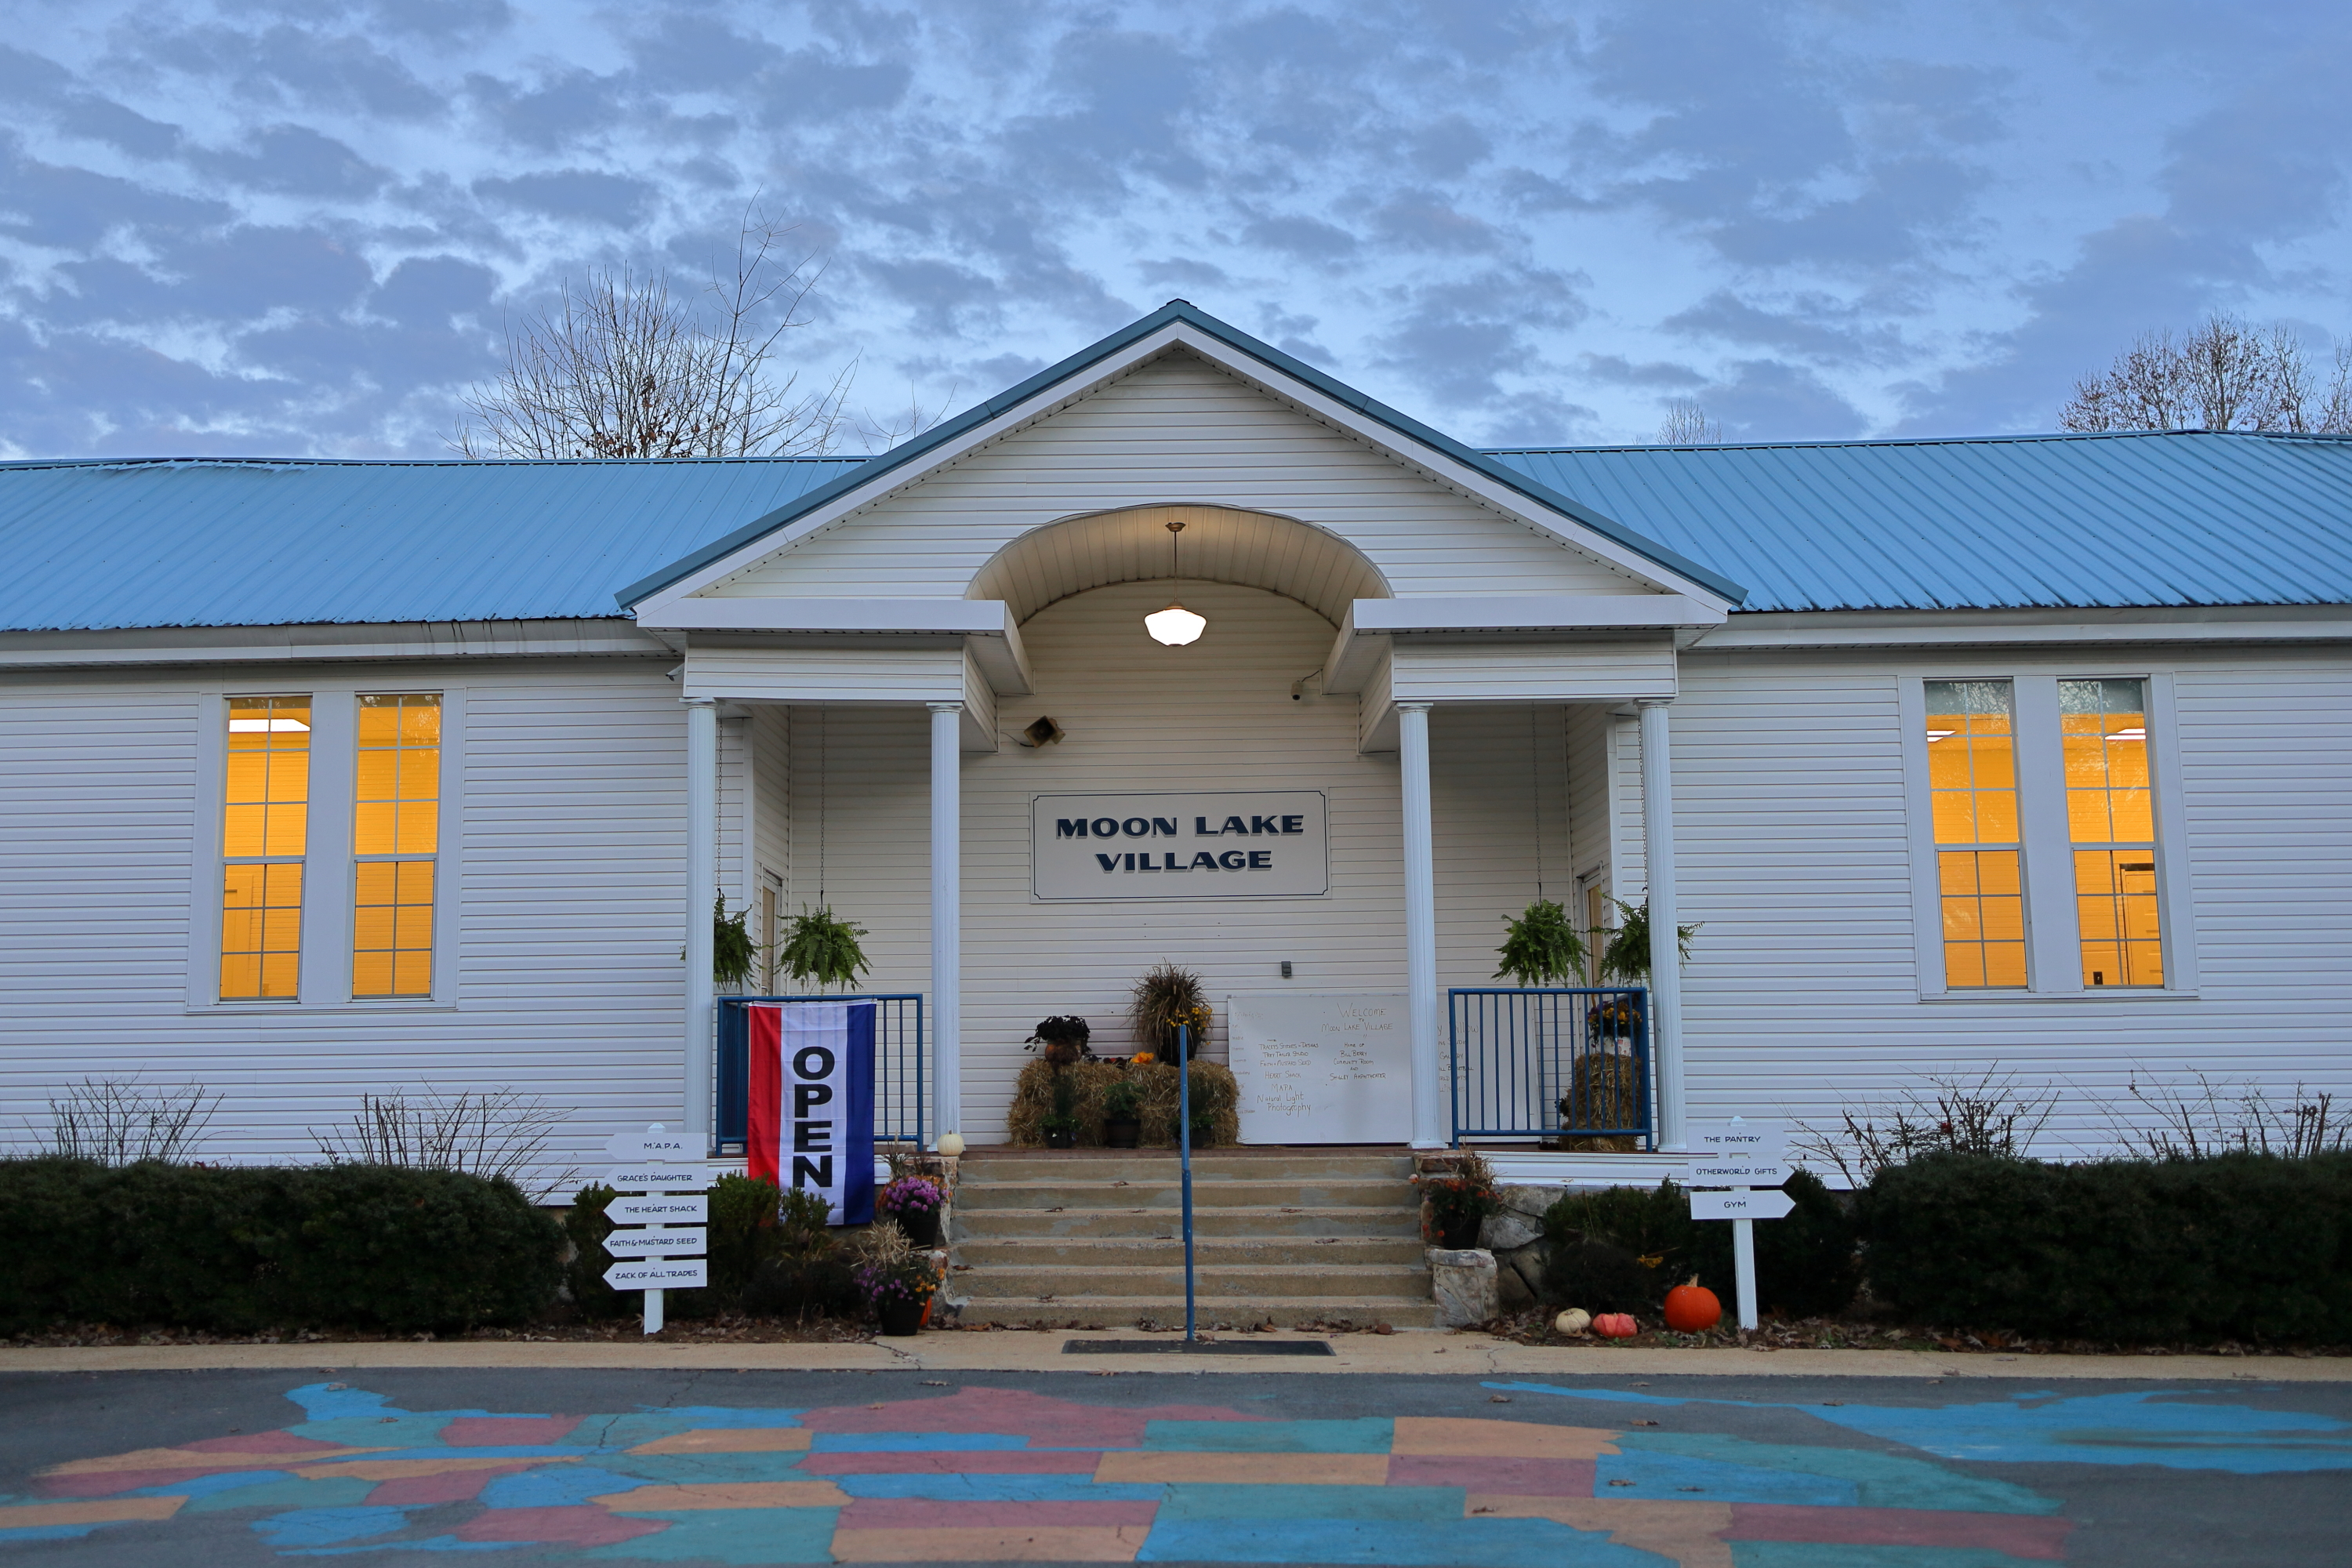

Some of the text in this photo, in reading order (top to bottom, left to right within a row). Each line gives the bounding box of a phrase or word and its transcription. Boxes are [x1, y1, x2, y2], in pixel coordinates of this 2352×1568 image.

[1056, 815, 1305, 839] MOON LAKE
[1094, 850, 1273, 873] VILLAGE
[1338, 1003, 1386, 1018] WELCOME
[1322, 1023, 1340, 1032] MOON
[1344, 1022, 1360, 1031] LAKE
[1265, 1071, 1283, 1080] HEART
[1258, 1094, 1280, 1104] Natural
[1287, 1091, 1304, 1105] Light
[1267, 1102, 1311, 1117] Photography
[792, 1046, 835, 1188] OPEN
[617, 1174, 648, 1182] GRACE'S
[638, 1238, 674, 1247] MUSTARD
